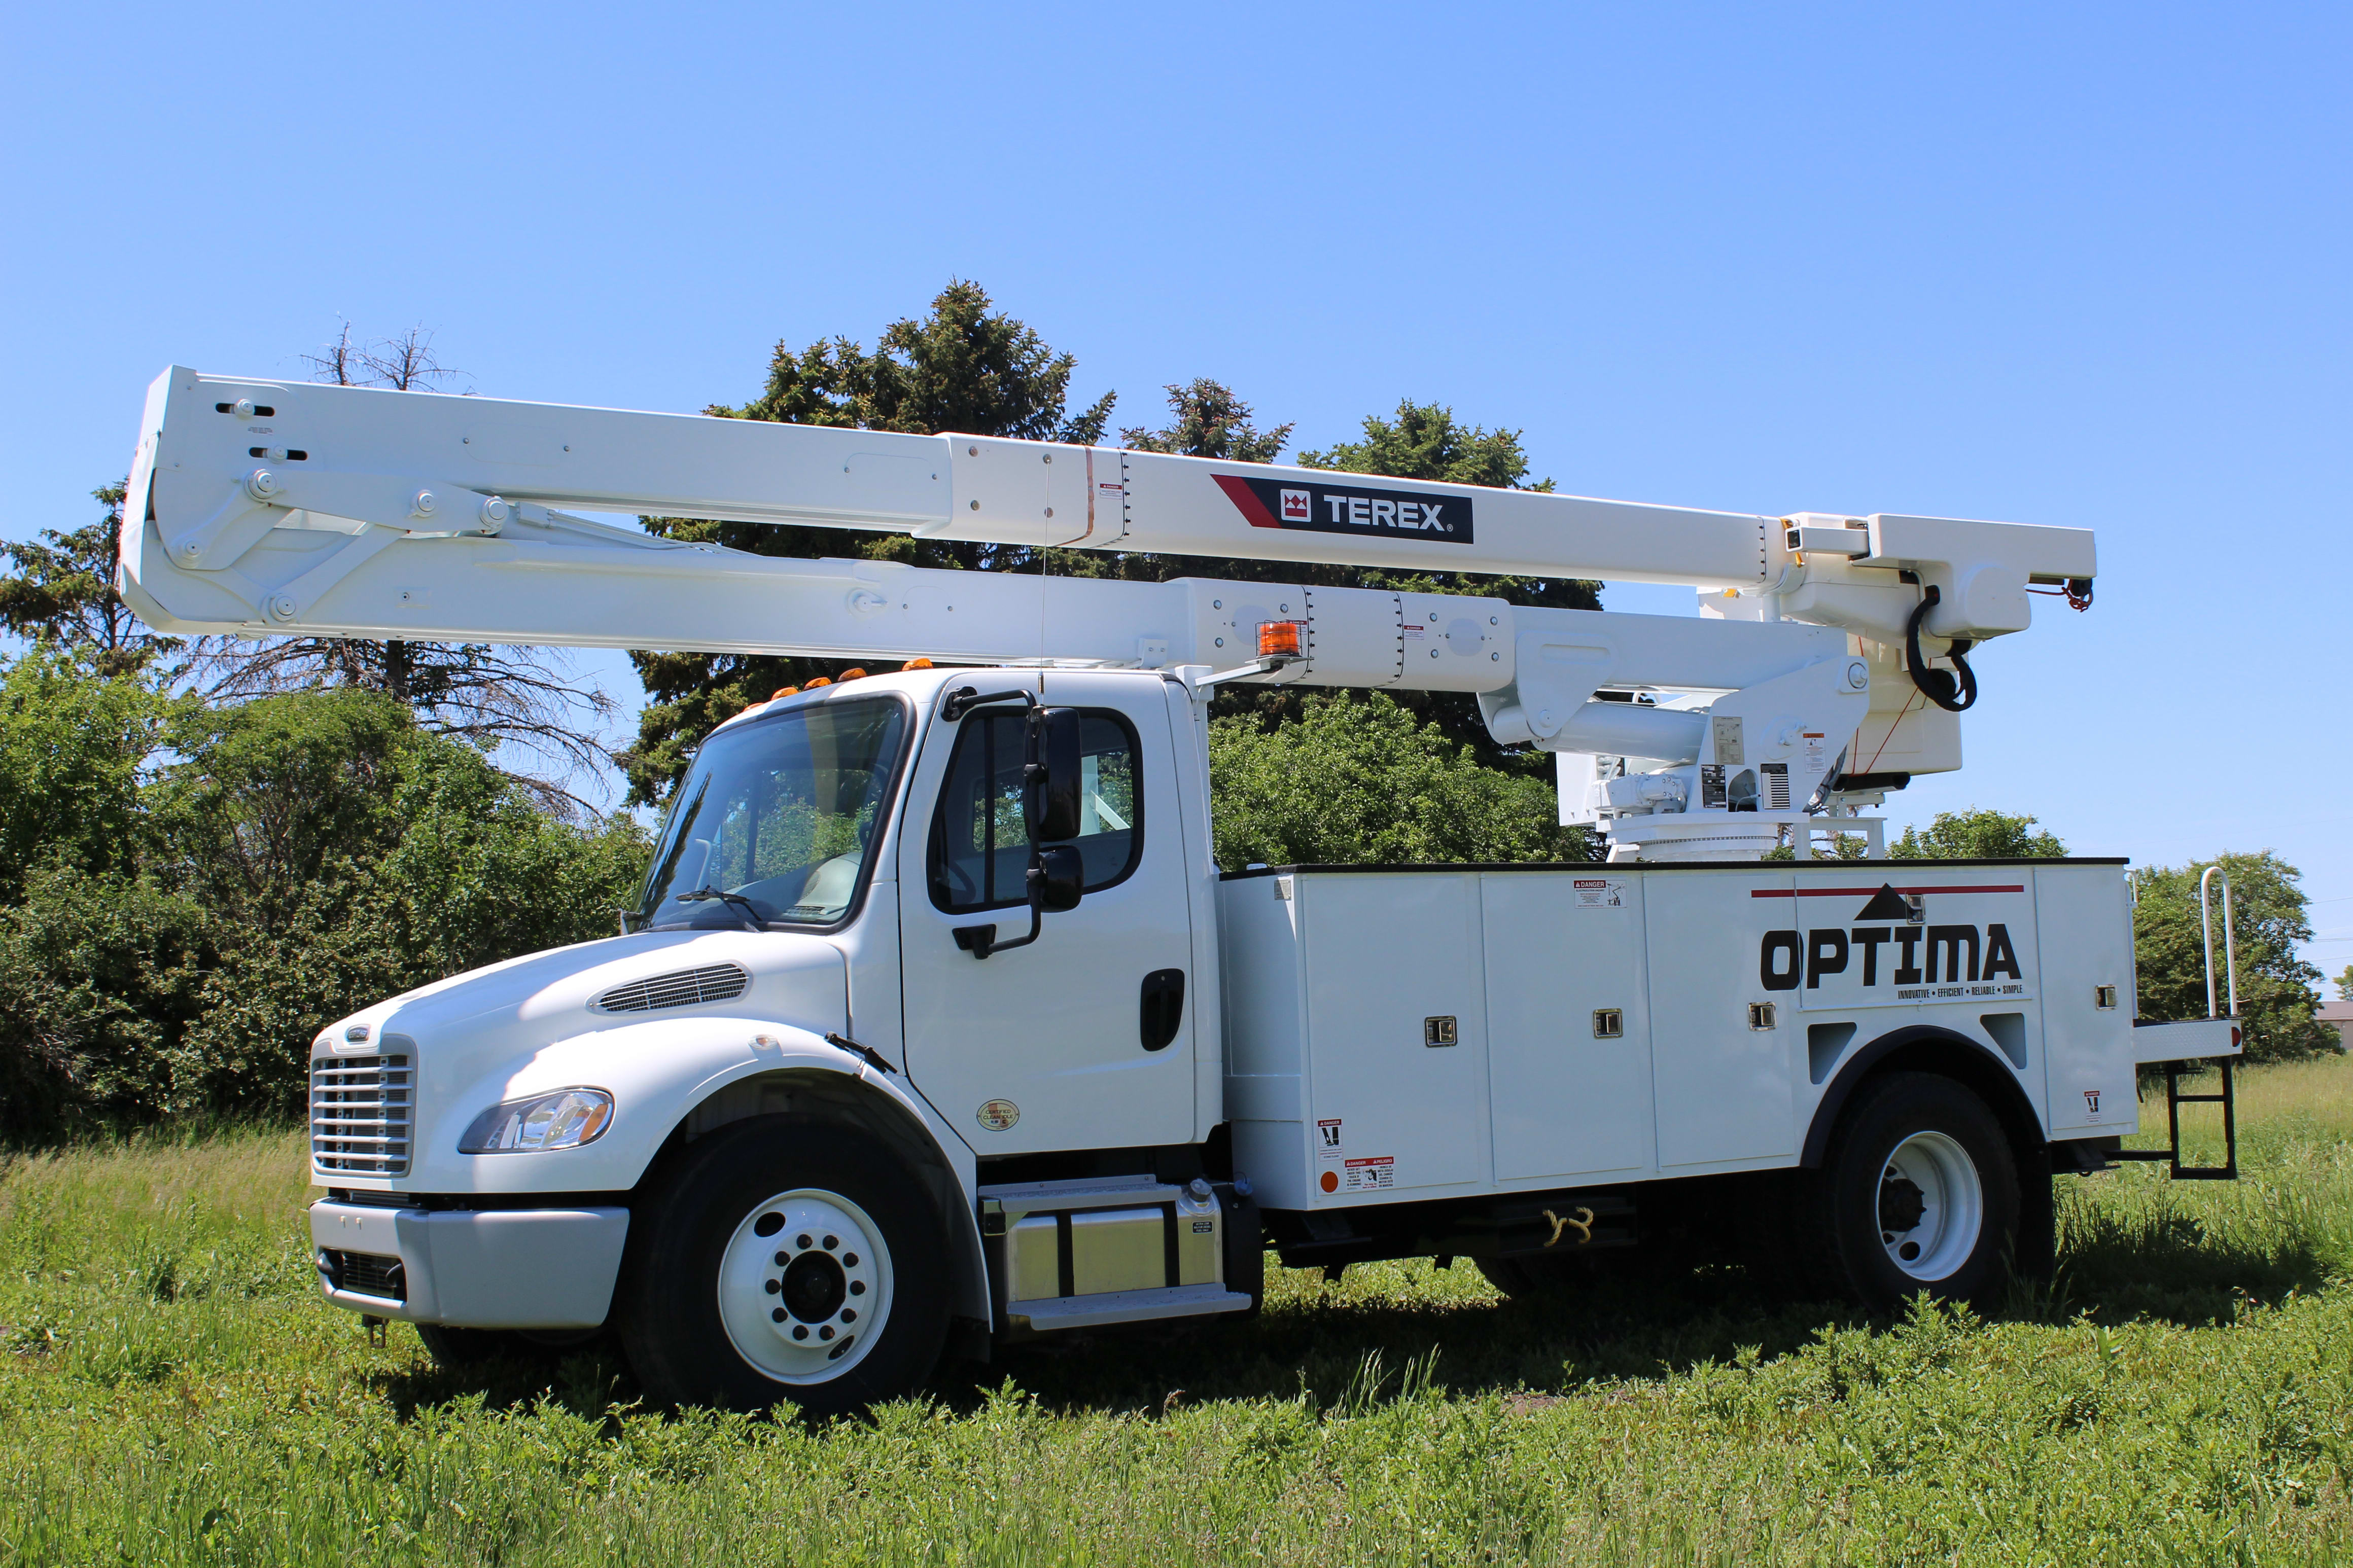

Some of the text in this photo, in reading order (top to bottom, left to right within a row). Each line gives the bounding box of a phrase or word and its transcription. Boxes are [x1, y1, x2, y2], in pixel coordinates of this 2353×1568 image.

[1323, 494, 1445, 531] TEREX
[1760, 923, 2022, 991] OPTIMA
[1898, 984, 2022, 1000] INNOVATIVE EFFICIENT RELIABLE SIMPLE
